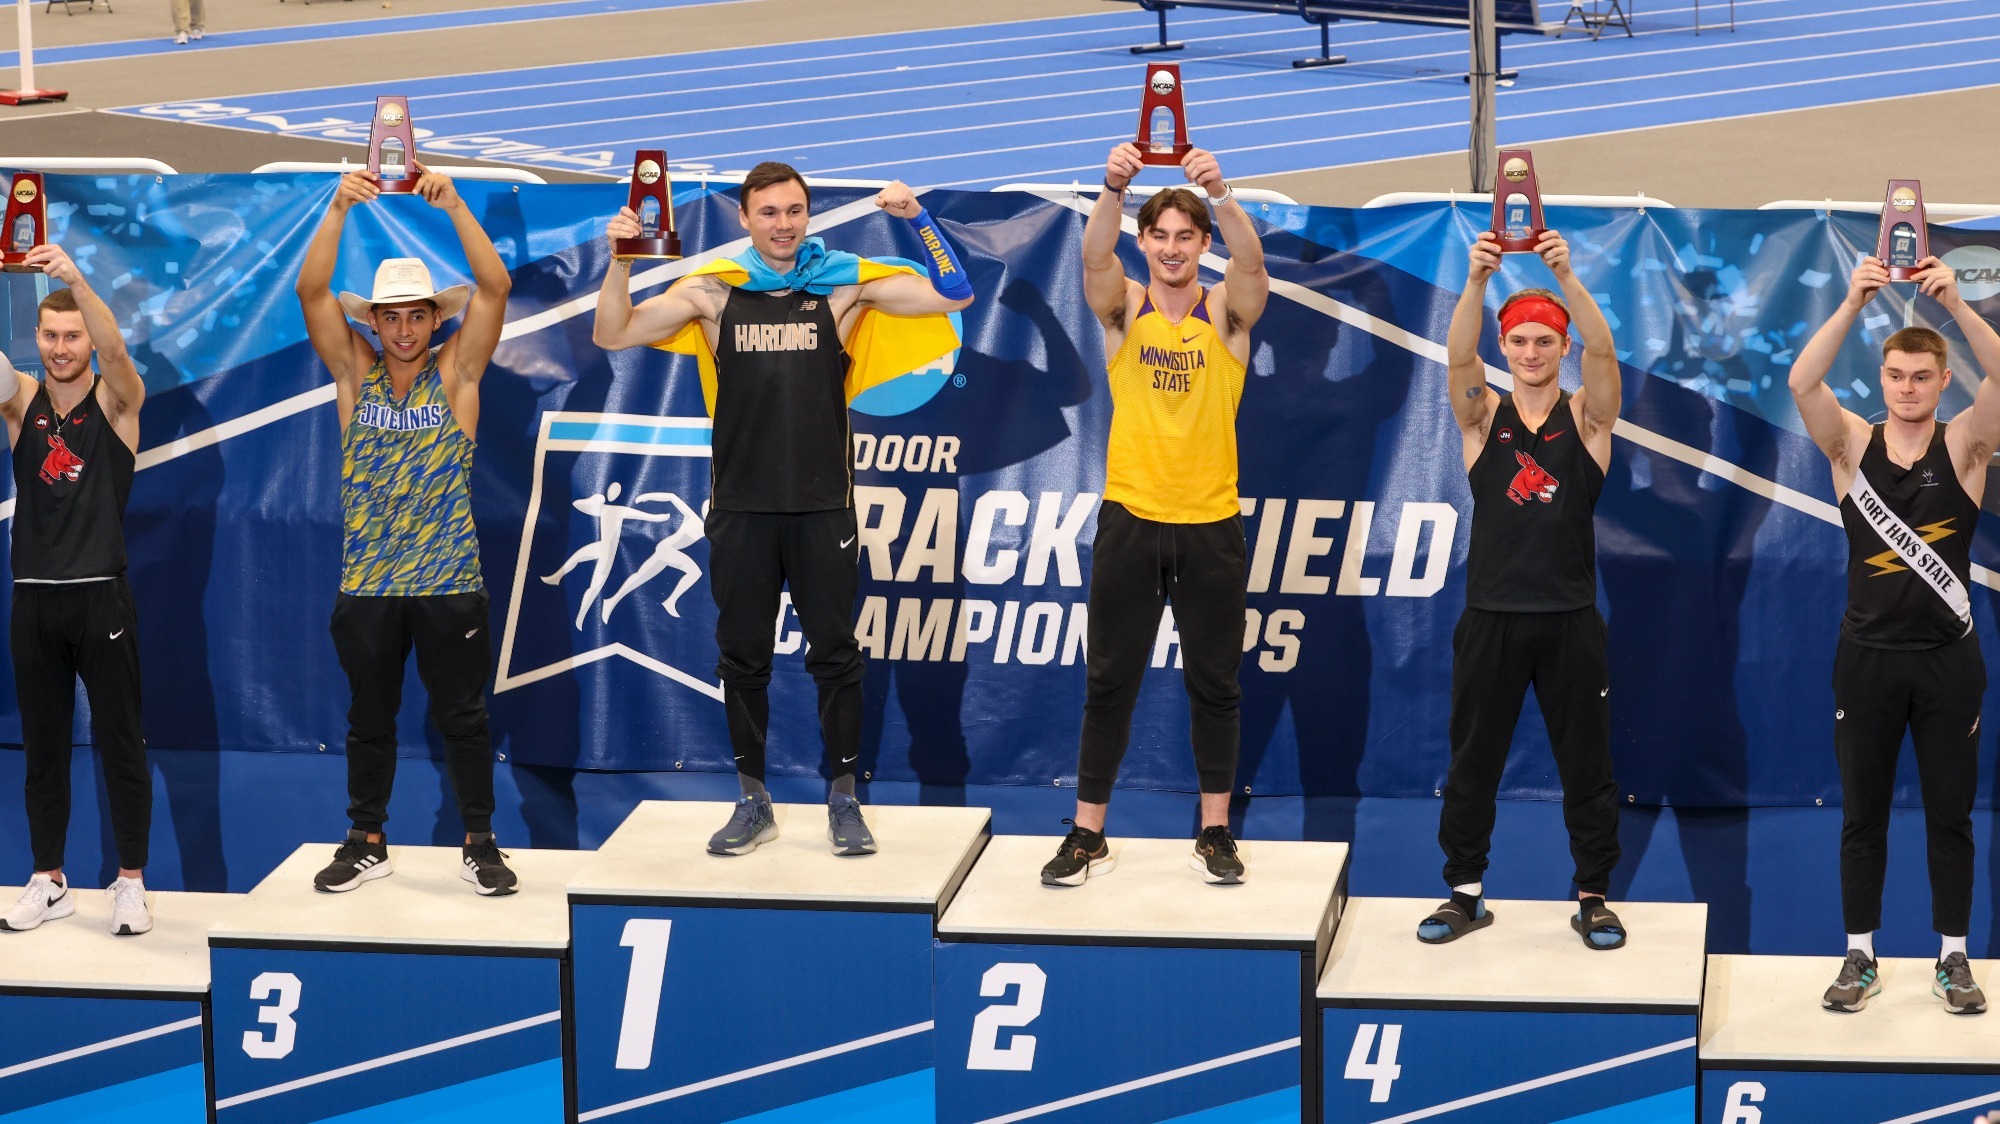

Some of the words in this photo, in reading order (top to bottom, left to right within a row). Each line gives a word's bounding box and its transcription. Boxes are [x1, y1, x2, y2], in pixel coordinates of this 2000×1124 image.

[919, 225, 957, 277] UKRAINE
[734, 322, 818, 353] HARDING
[1152, 369, 1191, 393] STATE
[853, 432, 961, 474] DOOR
[853, 484, 1099, 588] RACK
[1238, 497, 1459, 598] IELD
[1859, 489, 1892, 527] FORT
[1884, 522, 1922, 558] HAYS
[1917, 553, 1956, 594] STATE
[242, 972, 302, 1059] 3
[615, 918, 672, 1070] 1
[966, 962, 1047, 1071] 2
[1343, 1023, 1403, 1103] 4
[1722, 1082, 1766, 1124] 6
